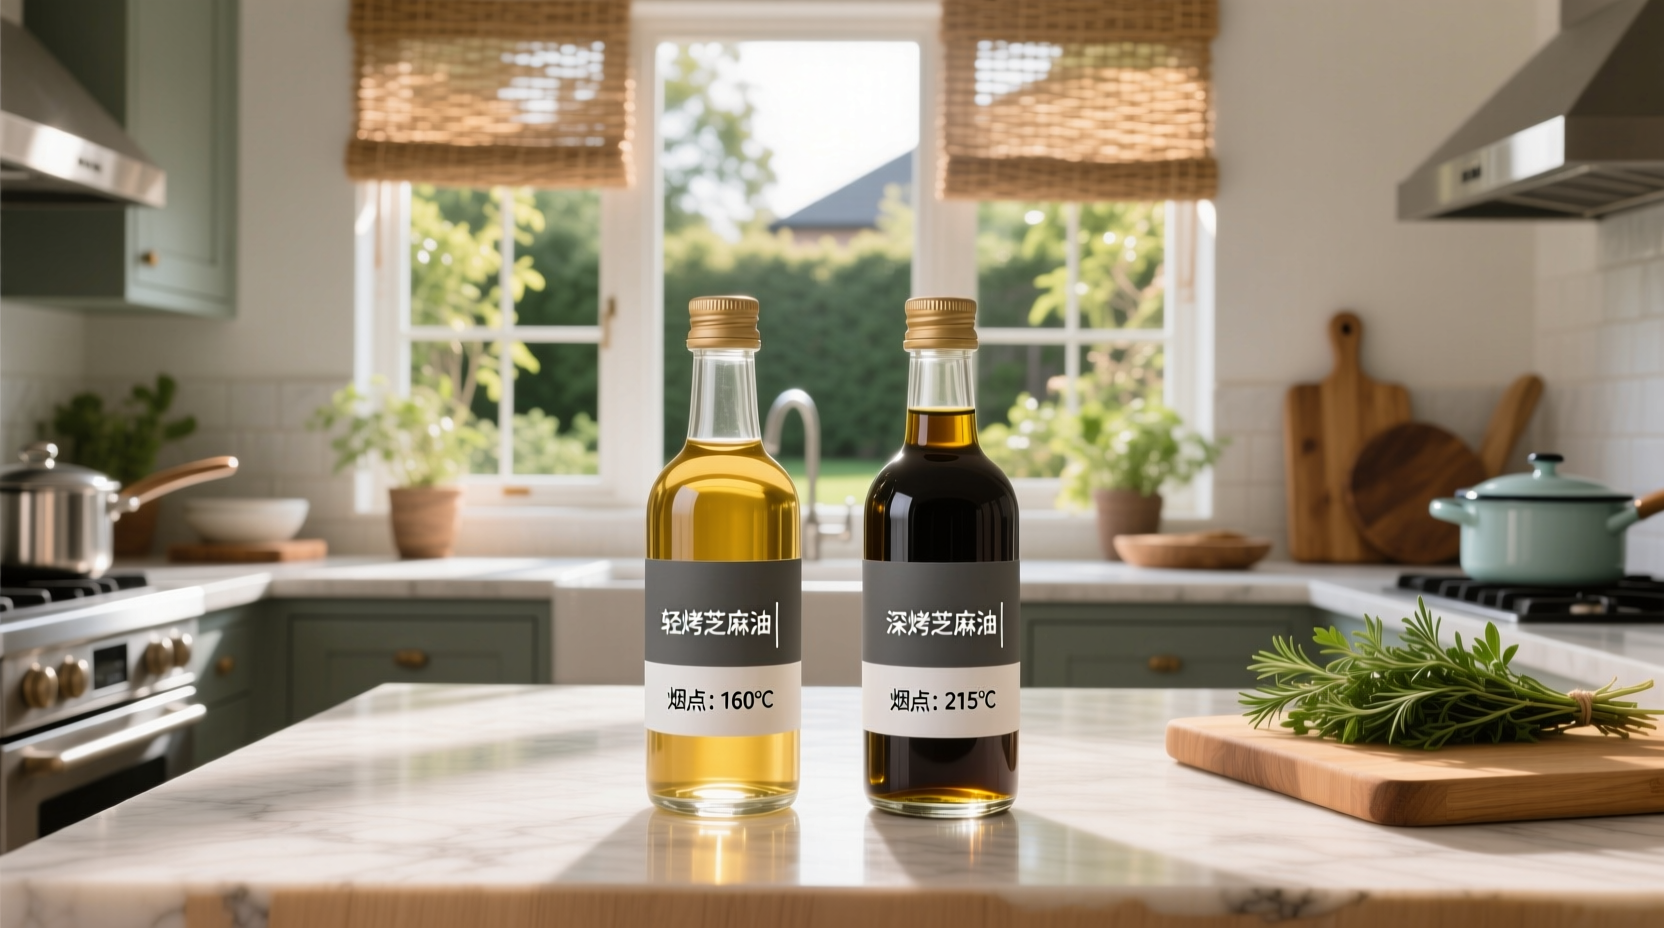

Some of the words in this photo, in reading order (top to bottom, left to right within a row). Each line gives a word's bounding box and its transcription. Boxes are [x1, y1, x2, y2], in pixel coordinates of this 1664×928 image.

[661, 608, 771, 636] 轻烤芝麻油
[886, 609, 997, 637] 深烤芝麻油
